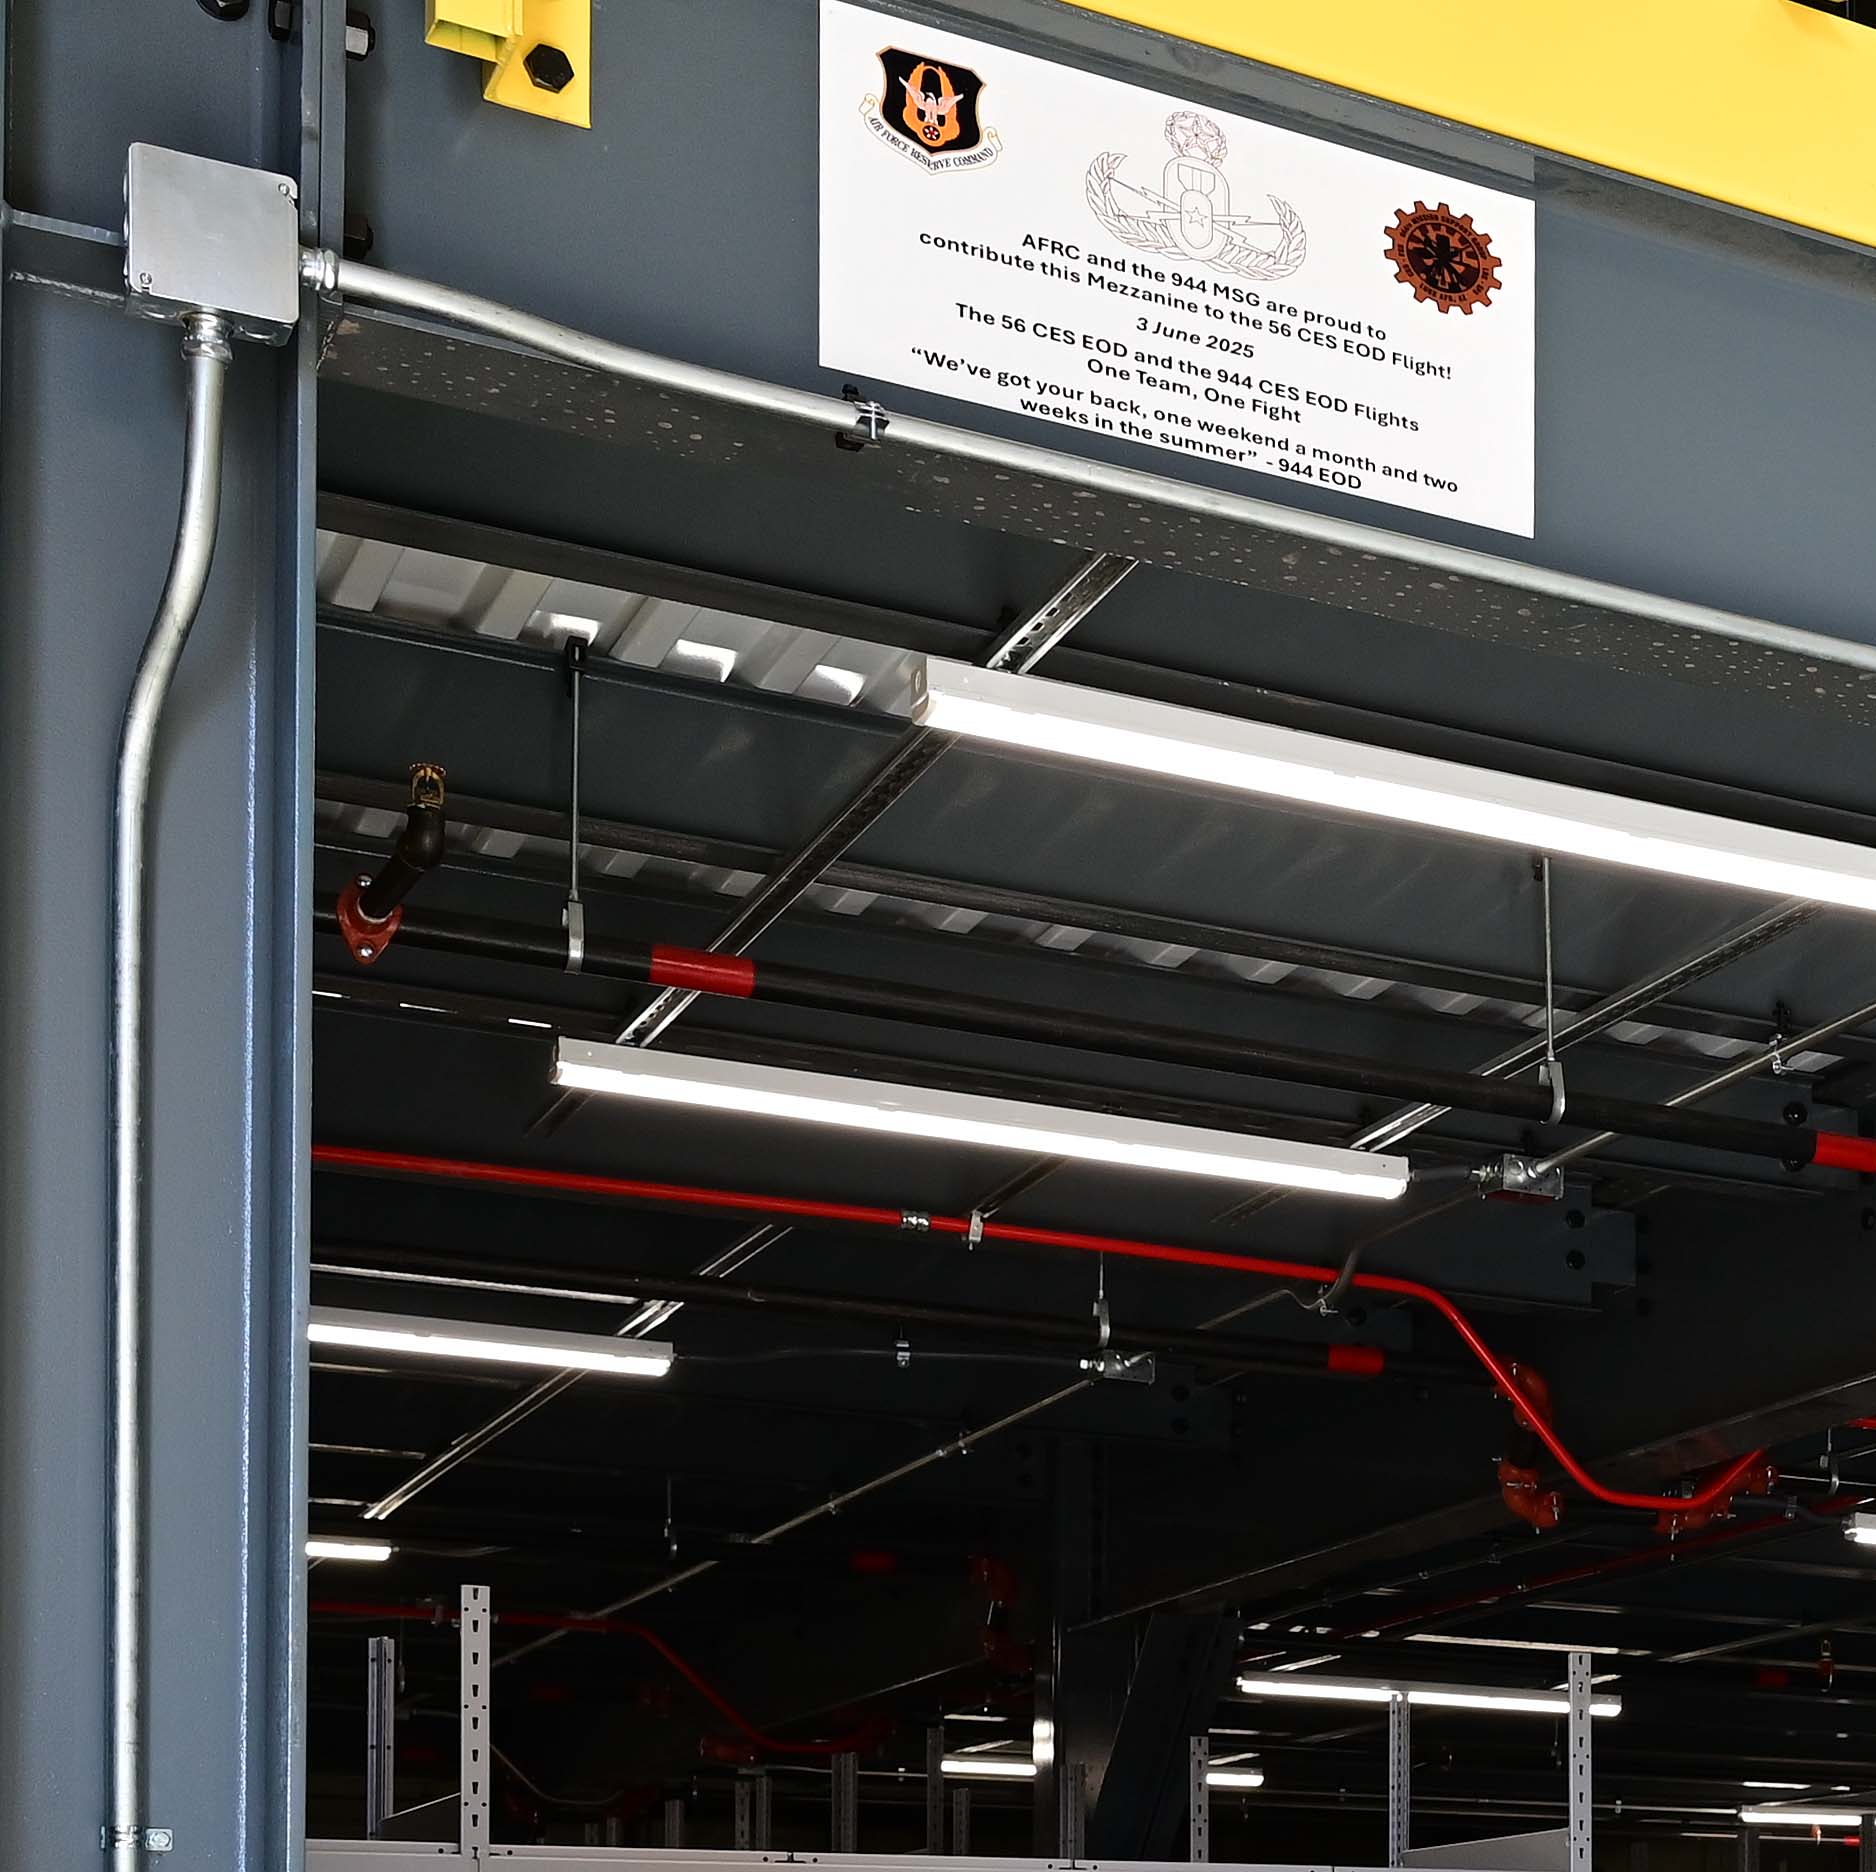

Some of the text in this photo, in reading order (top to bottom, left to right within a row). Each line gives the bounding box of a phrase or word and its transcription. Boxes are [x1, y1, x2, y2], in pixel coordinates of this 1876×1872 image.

[869, 117, 994, 171] AIR FORCE RESERVE COMMAND
[919, 233, 1451, 380] contribute this Mezzanine to the 56 CES EOD Flight!
[1021, 233, 1386, 341] AFRC and the 944 MSG are proud to
[955, 302, 1419, 432] The 56 CES EOD and the 944 CES EOD Flights
[1136, 317, 1255, 359] 3 June 2025
[911, 347, 1458, 493] “We’ve got your back, one weekend a month and two
[1087, 358, 1301, 424] One Team, One Fight
[1020, 398, 1089, 425] weeks
[1095, 413, 1113, 431] in
[1119, 420, 1153, 440] the
[1159, 432, 1257, 462] summer”
[1278, 458, 1314, 479] 944
[1319, 467, 1362, 490] EOD
